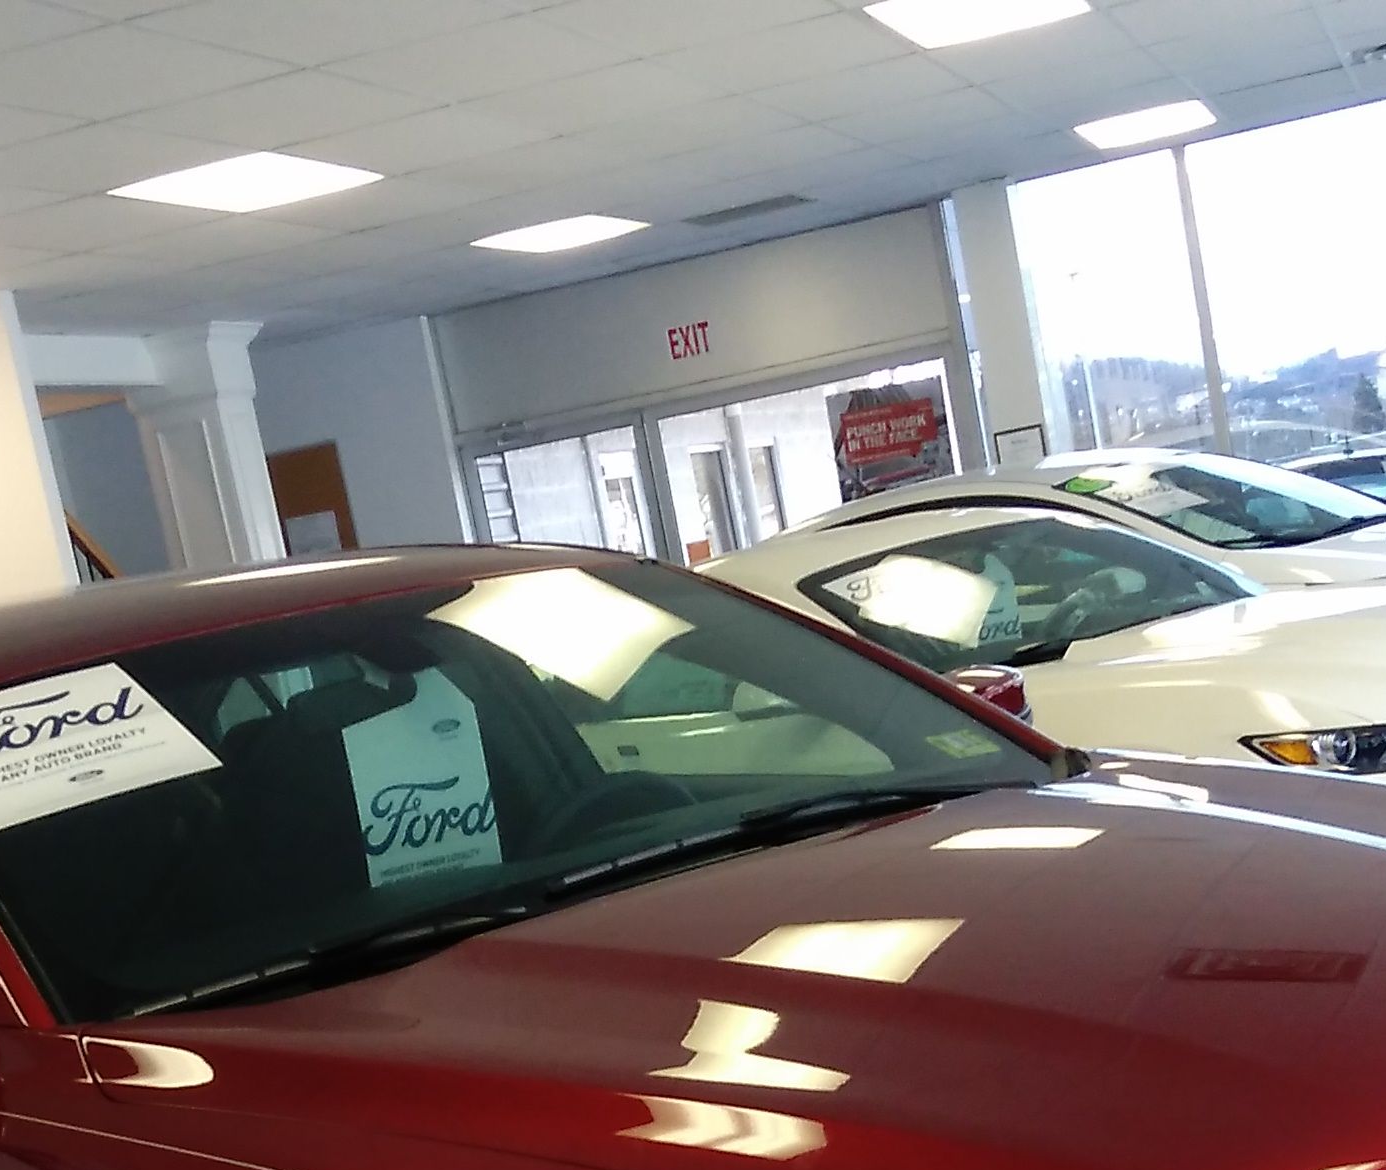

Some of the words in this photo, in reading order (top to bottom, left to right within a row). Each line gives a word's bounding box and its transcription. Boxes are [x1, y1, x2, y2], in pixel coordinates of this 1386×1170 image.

[667, 321, 709, 360] EXIT
[846, 421, 886, 440] PUNCH
[890, 413, 926, 430] WORK
[848, 437, 861, 452] IN
[979, 607, 1021, 641] ord
[1, 769, 28, 783] ANY
[33, 756, 71, 773] AUTO
[73, 743, 122, 760] BRAND
[34, 742, 85, 763] OWNER
[88, 726, 146, 748] LOYALTY
[365, 776, 496, 856] Ford
